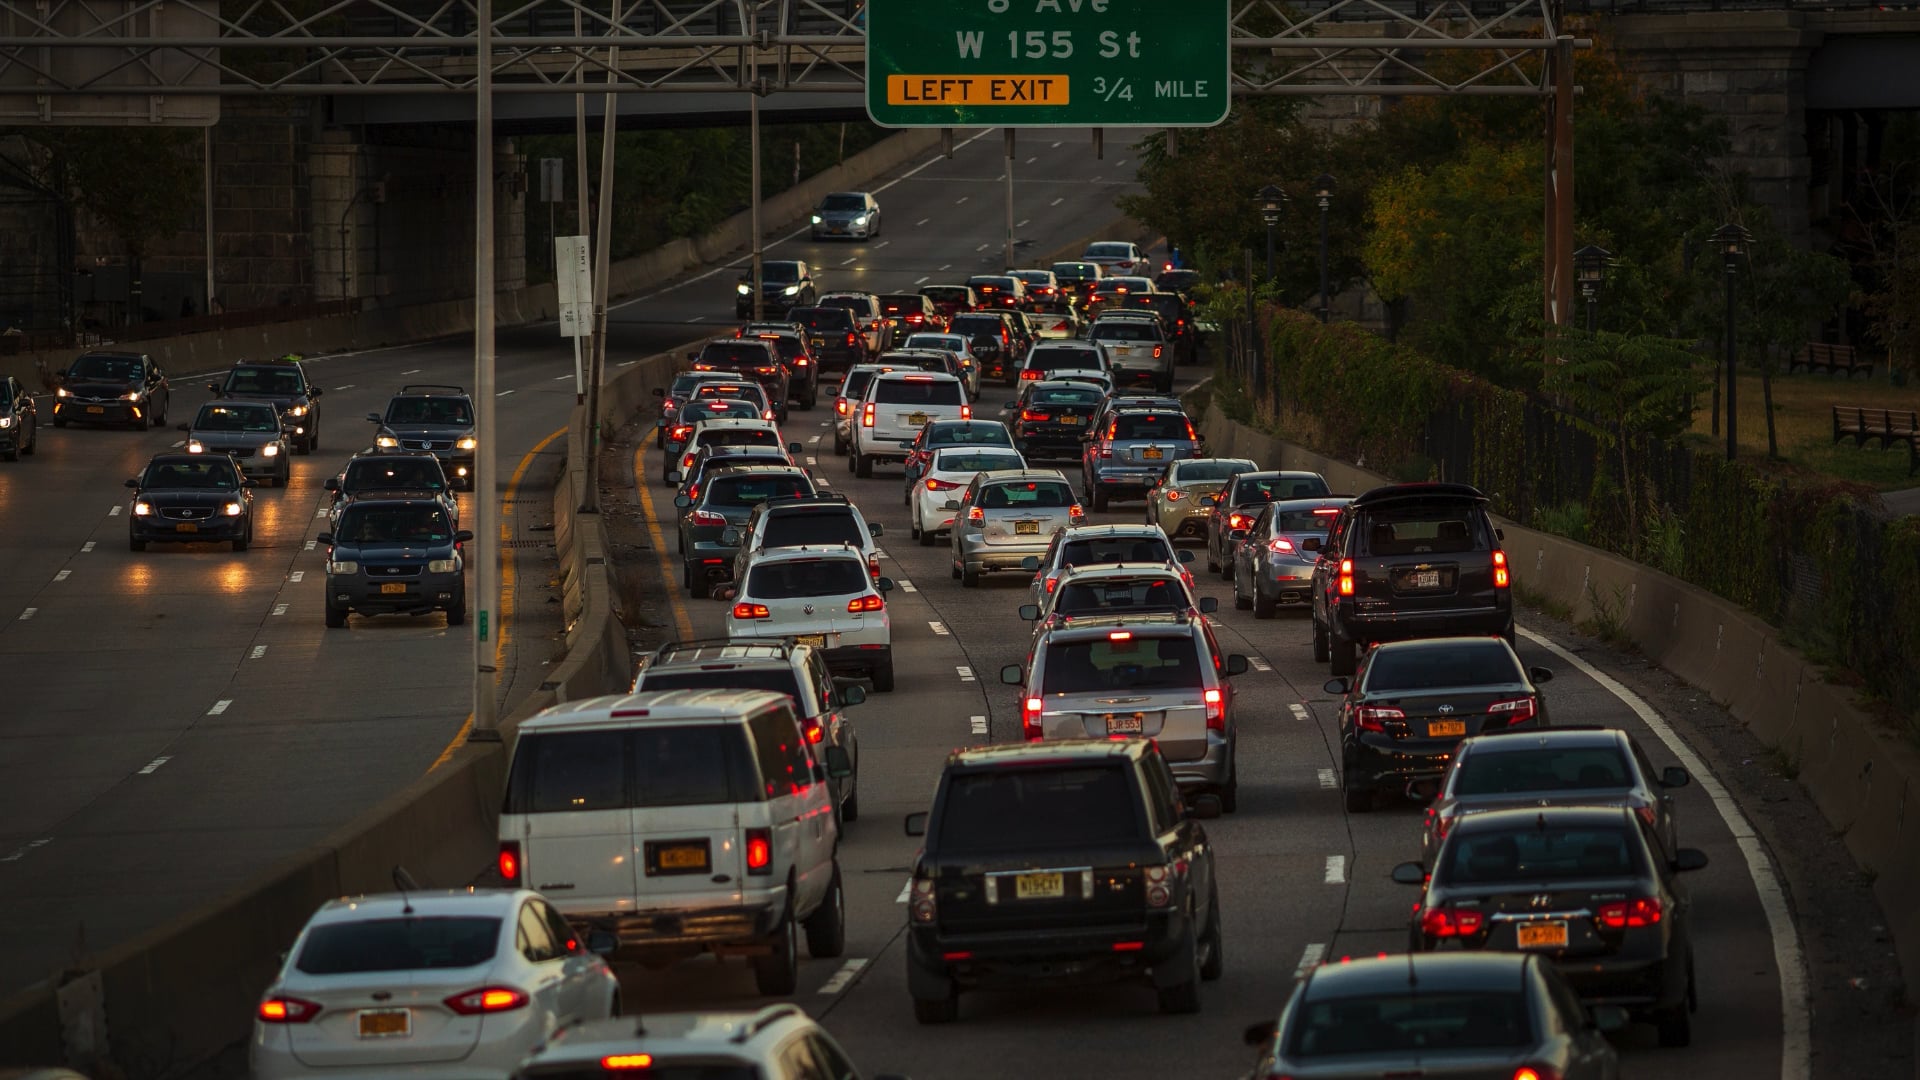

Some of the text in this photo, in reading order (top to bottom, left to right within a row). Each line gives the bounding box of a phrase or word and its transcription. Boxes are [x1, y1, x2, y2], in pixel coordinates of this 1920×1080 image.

[956, 30, 1141, 59] W 155 St
[903, 79, 1054, 101] LEFT EXIT
[1155, 80, 1208, 99] MILE
